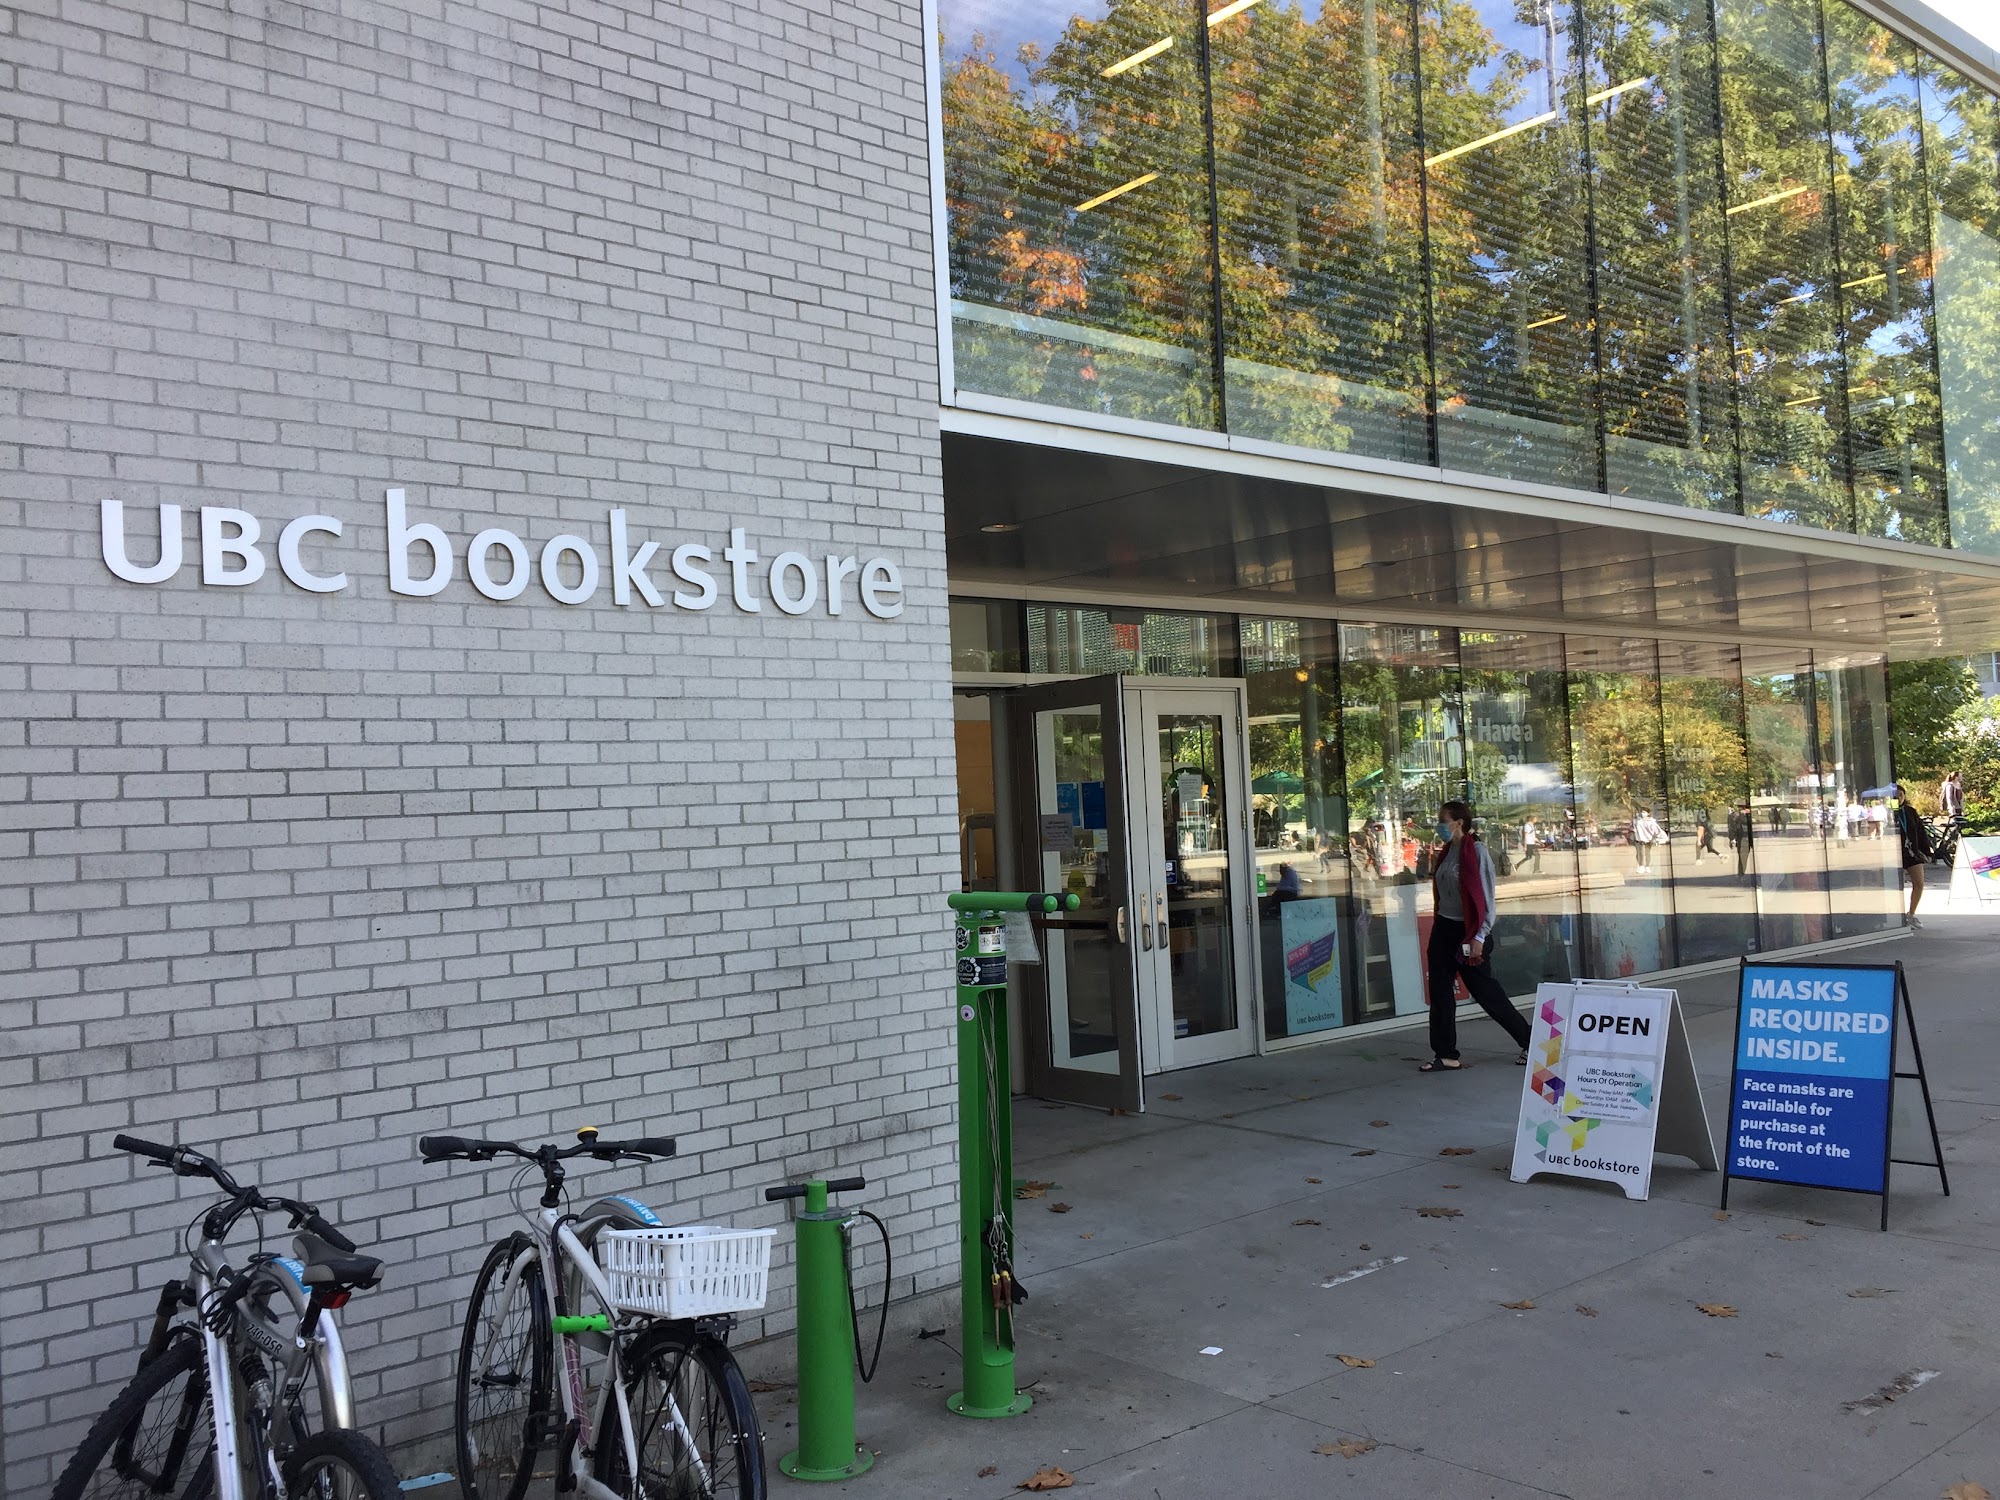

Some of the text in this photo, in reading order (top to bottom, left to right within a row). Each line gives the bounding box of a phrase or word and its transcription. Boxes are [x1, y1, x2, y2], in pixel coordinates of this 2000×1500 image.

[1037, 165, 1049, 176] saw
[1052, 170, 1068, 182] says
[1060, 185, 1076, 198] shall
[961, 239, 979, 250] taste
[964, 255, 983, 267] think
[972, 272, 981, 281] to
[982, 274, 997, 285] told
[99, 487, 905, 619] UBC bookstore
[1478, 717, 1534, 742] Have a
[1480, 749, 1526, 780] great
[1750, 978, 1849, 1002] MASKS
[1307, 1012, 1336, 1023] bookstore
[1578, 1013, 1650, 1037] OPEN
[1749, 1007, 1890, 1035] REQUIRED
[1747, 1038, 1846, 1064] INSIDE.
[1577, 1075, 1643, 1088] Hours Of Operation
[1586, 1067, 1636, 1079] UBC Bookstore
[1743, 1078, 1854, 1099] Face masks are
[1742, 1096, 1833, 1117] available for
[1740, 1117, 1826, 1138] purchase at
[1739, 1135, 1851, 1159] the front of the
[1548, 1154, 1640, 1175] UBC bookstore
[1737, 1155, 1780, 1171] store.
